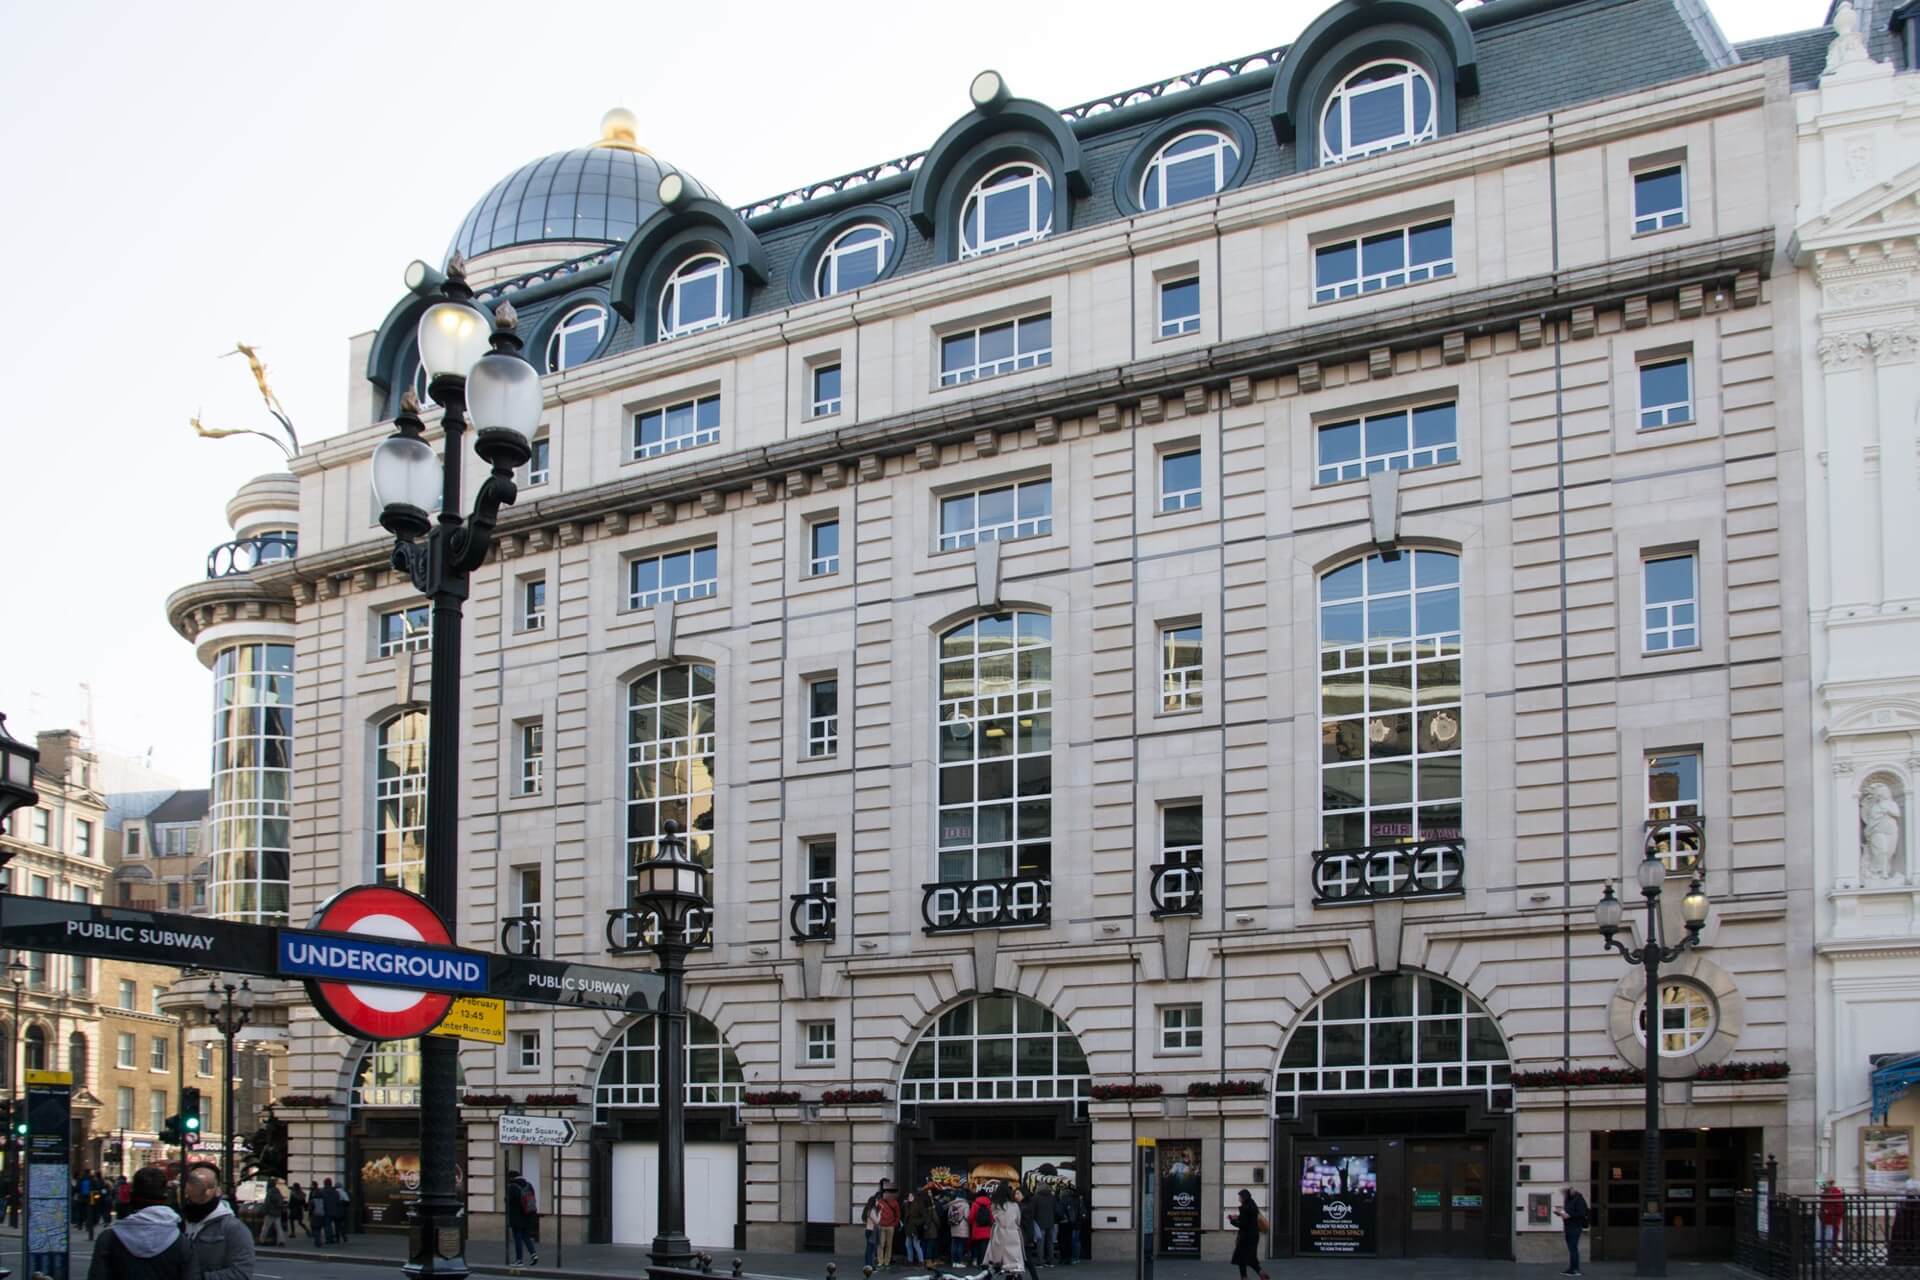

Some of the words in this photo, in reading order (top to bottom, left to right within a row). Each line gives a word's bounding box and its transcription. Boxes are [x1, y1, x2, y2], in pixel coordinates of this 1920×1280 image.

[67, 920, 134, 942] PUBLIC
[139, 928, 214, 950] SUBWAY
[288, 942, 481, 982] UNDERGROUND
[528, 974, 575, 990] PUBLIC
[578, 978, 630, 995] SUBWAY
[502, 1117, 514, 1125] The
[516, 1118, 530, 1127] City
[502, 1125, 533, 1135] Trafalgar
